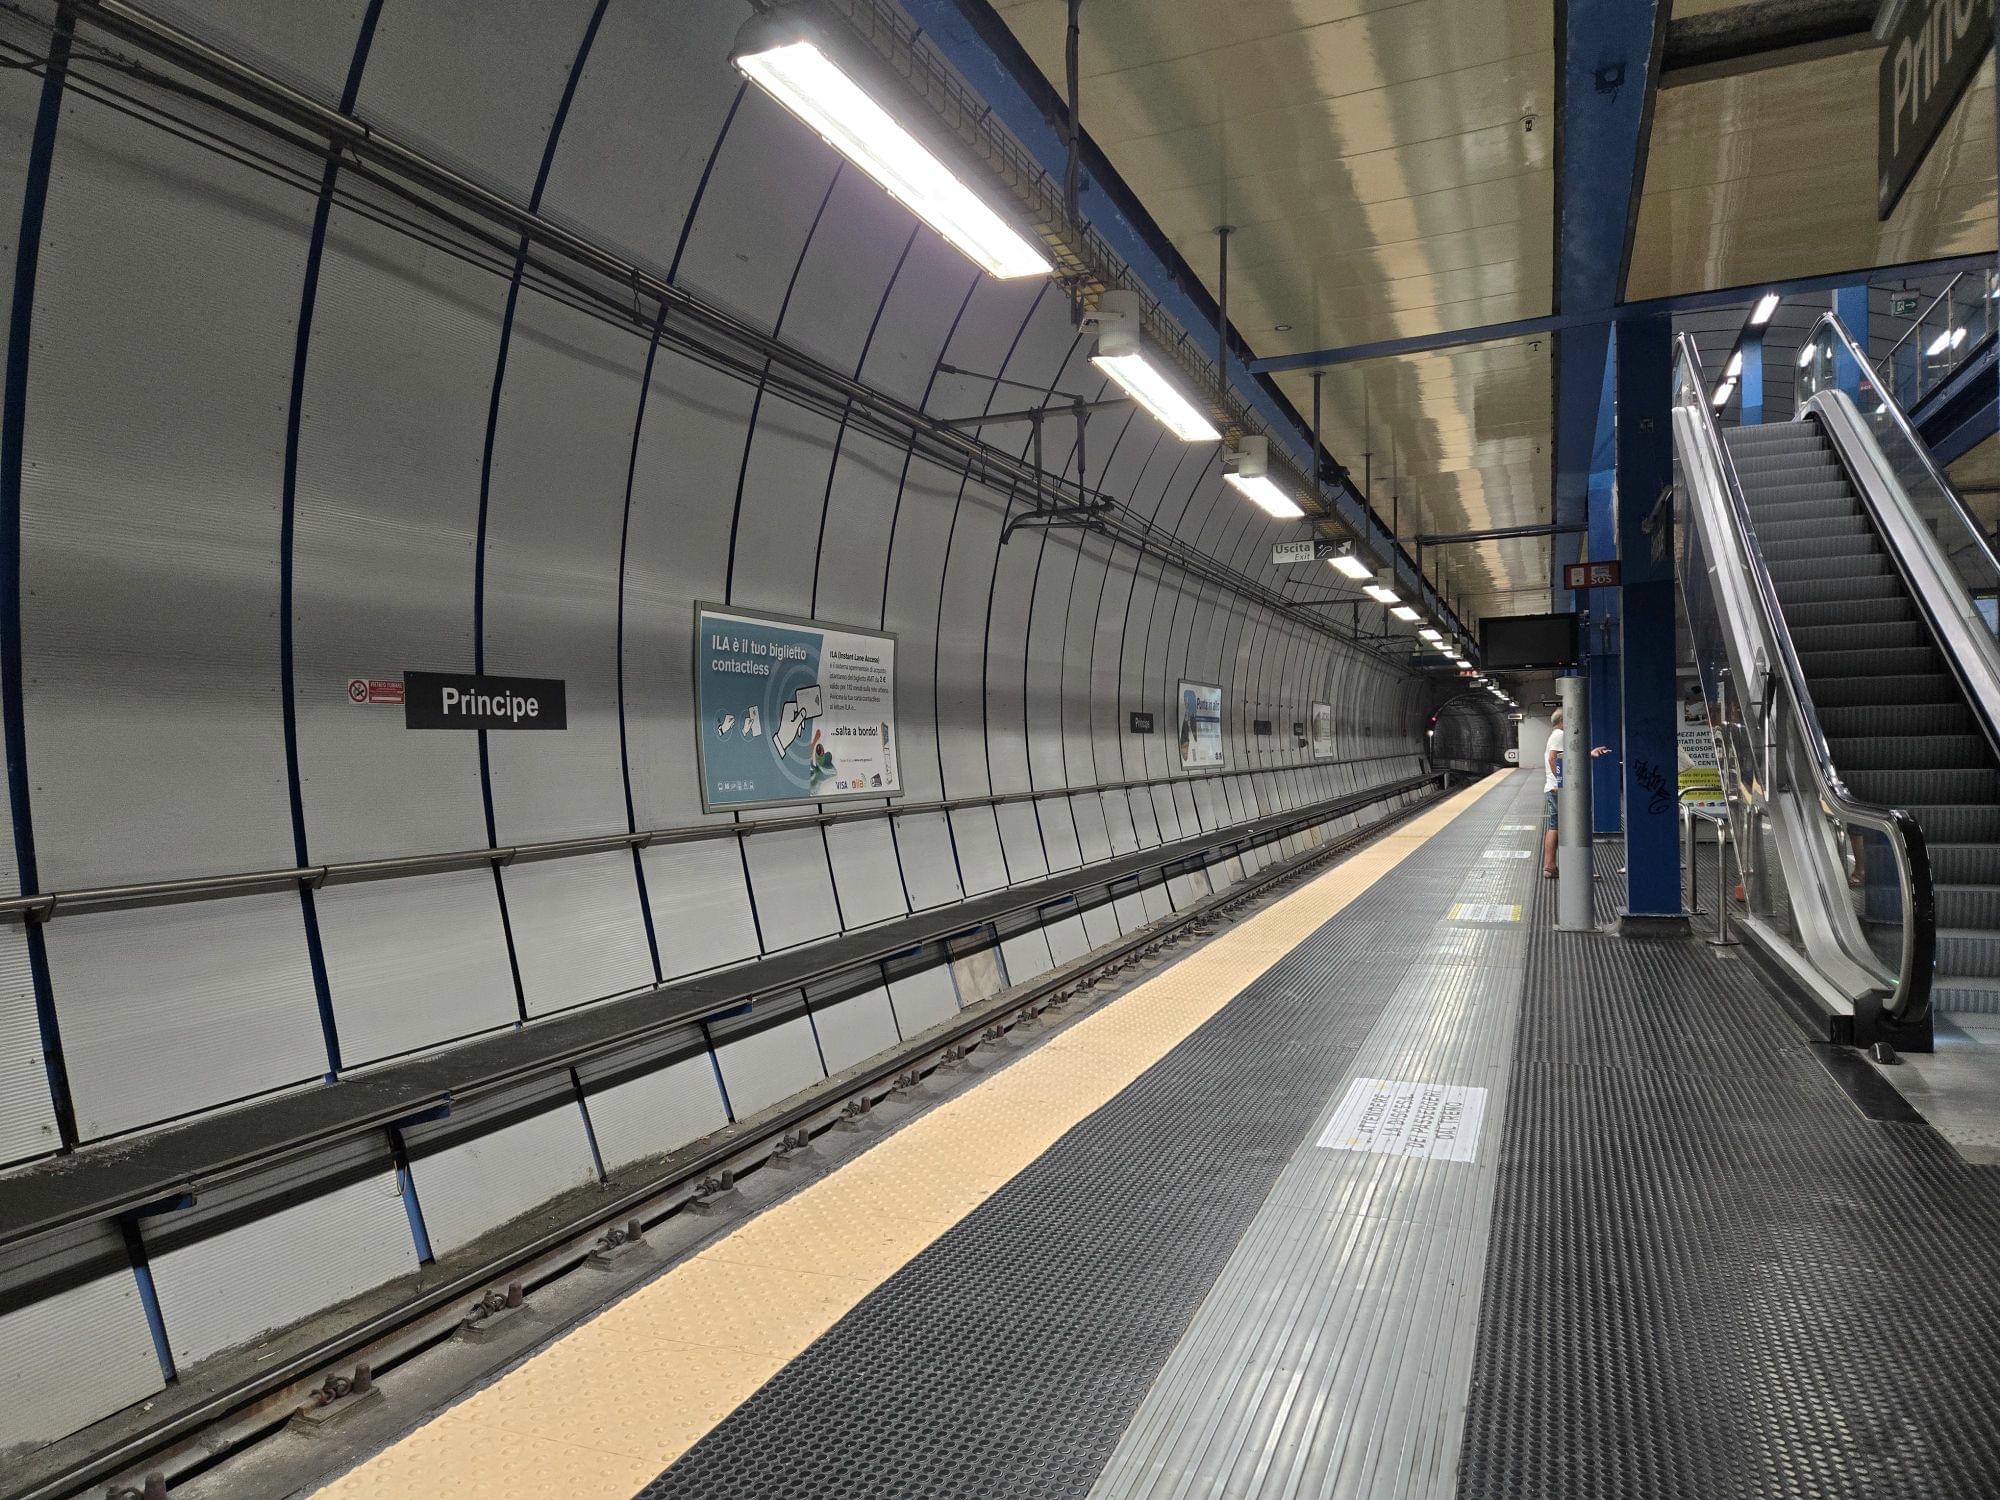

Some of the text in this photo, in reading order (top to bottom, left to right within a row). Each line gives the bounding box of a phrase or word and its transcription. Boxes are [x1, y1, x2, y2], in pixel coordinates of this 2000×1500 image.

[1276, 544, 1310, 554] Uscita
[1591, 575, 1612, 584] SOS
[712, 634, 807, 661] ILA è il tuo biglietto
[712, 658, 769, 676] contactless
[442, 687, 539, 722] Principe
[858, 725, 878, 736] bordo!
[836, 781, 848, 790] VISA
[1356, 1093, 1390, 1133] ATTENDERE
[1386, 1095, 1414, 1125] DISCESA
[1435, 1101, 1462, 1140] DAL TRENO
[1405, 1134, 1426, 1148] DEI
